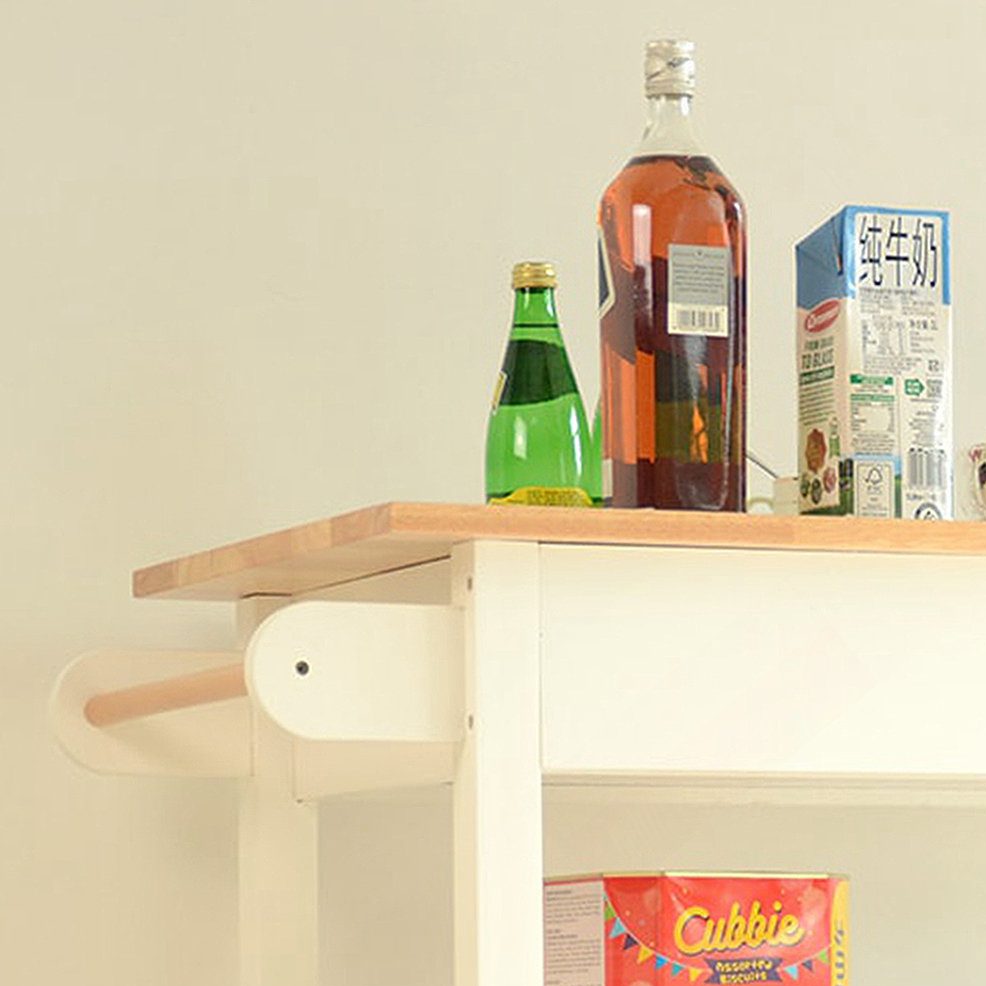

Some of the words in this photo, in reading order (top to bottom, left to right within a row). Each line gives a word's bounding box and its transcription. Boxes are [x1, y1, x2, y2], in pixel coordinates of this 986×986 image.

[858, 215, 938, 287] 纯牛奶
[673, 900, 805, 955] Cubbie
